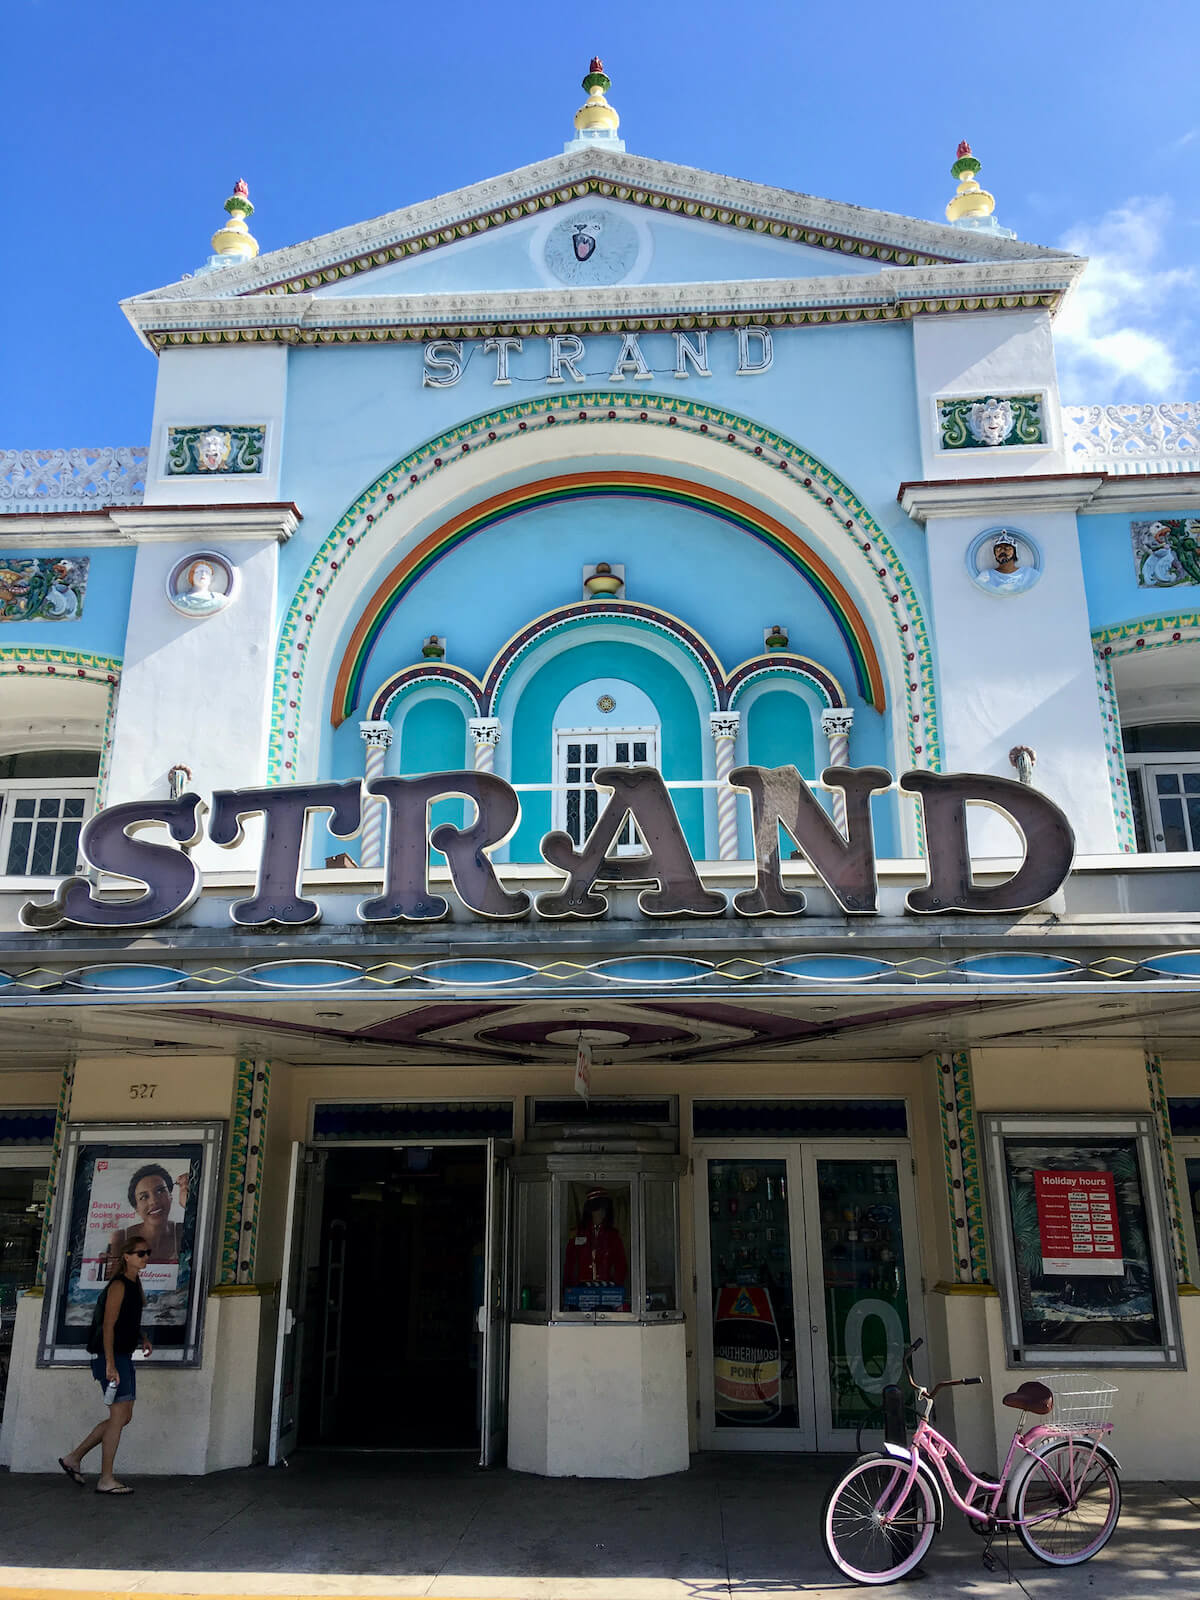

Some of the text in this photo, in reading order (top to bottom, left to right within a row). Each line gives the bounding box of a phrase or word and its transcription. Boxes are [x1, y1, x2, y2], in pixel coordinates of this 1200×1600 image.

[423, 325, 774, 388] STRAND
[18, 764, 1076, 930] STRAND
[129, 1083, 158, 1099] 527
[1042, 1176, 1107, 1186] Holiday hours
[92, 1201, 121, 1210] Beauty
[115, 1211, 136, 1220] good
[714, 1345, 778, 1361] OUTHERNMOST
